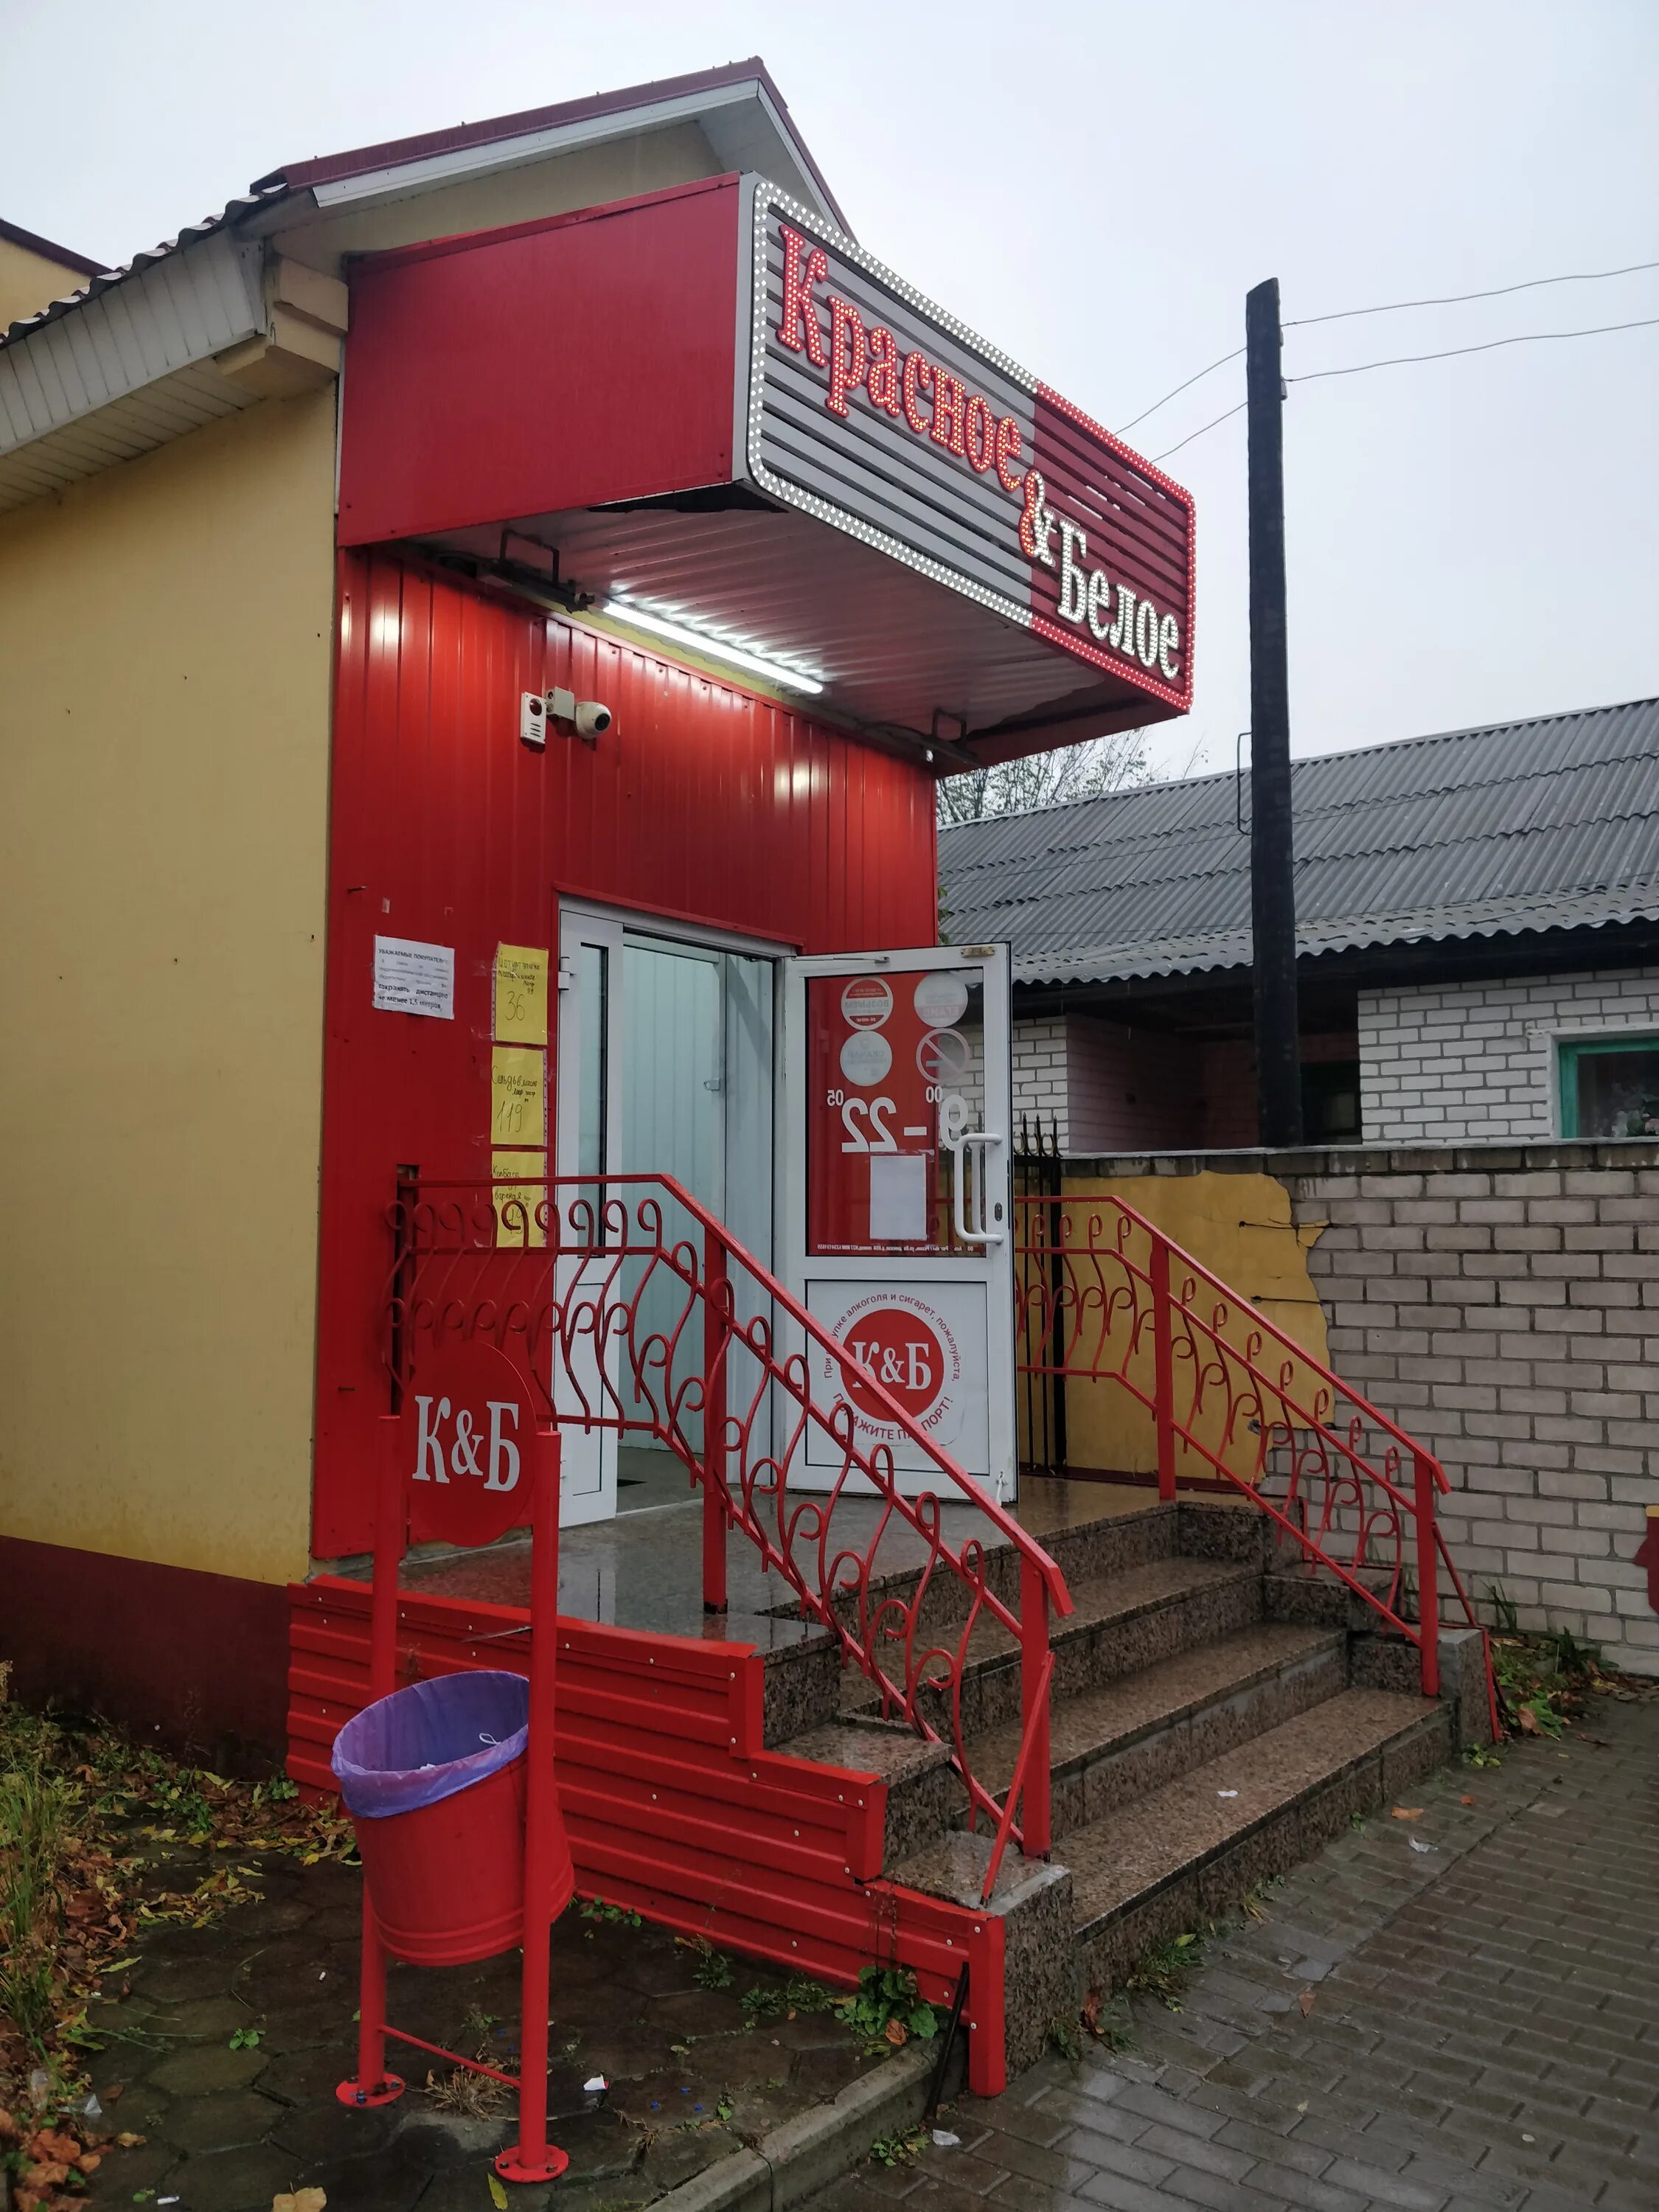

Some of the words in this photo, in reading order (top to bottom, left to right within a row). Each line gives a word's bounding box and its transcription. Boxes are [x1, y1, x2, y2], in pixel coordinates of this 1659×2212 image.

[777, 225, 1023, 492] Красное
[1019, 469, 1056, 568] &
[1058, 518, 1180, 680] Белое
[504, 991, 525, 1021] 36
[497, 1100, 523, 1133] 119
[846, 1294, 888, 1317] алкоголя
[899, 1295, 935, 1320] сигарет,
[936, 1317, 961, 1382] пожалуйста,
[852, 1340, 932, 1391] К&Б
[412, 1395, 521, 1492] К&Б
[897, 1397, 953, 1440] ППОРТ!
